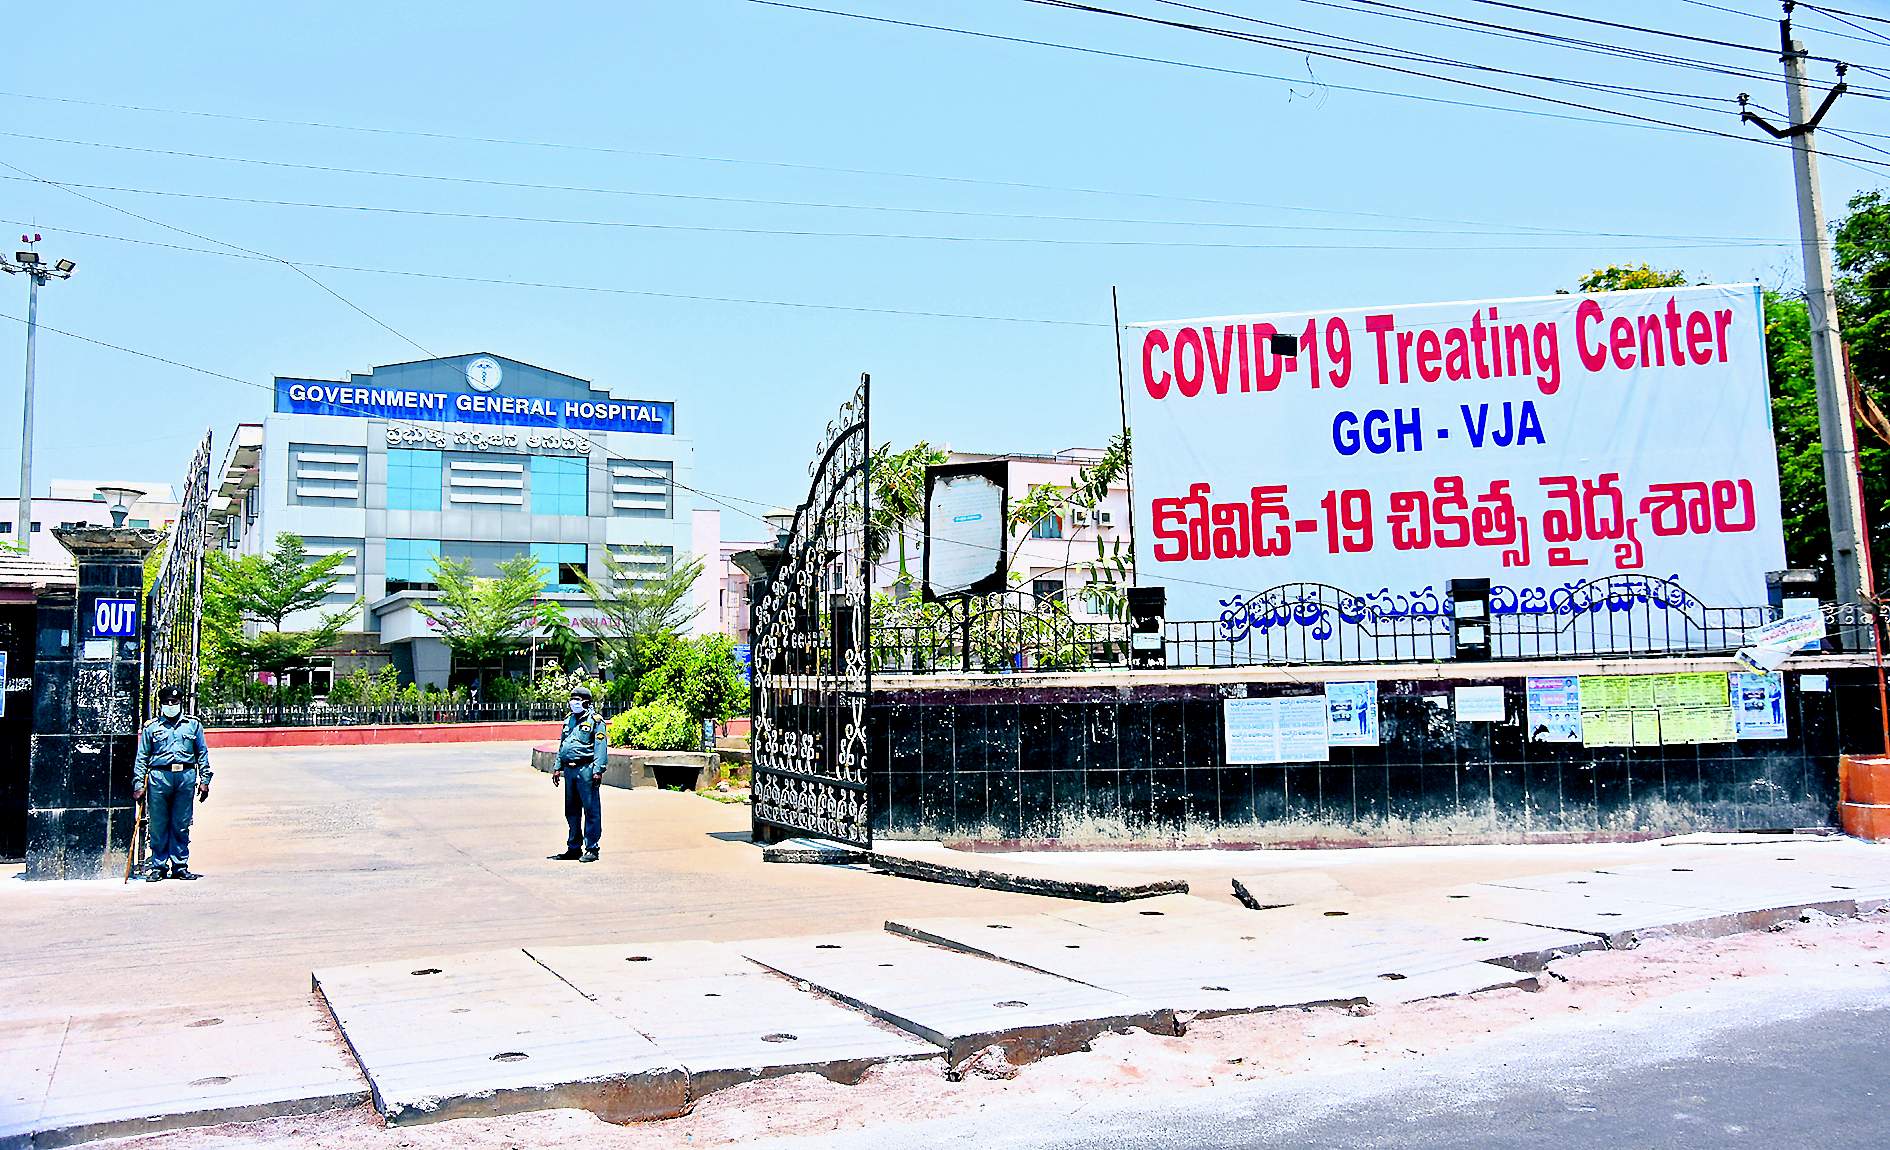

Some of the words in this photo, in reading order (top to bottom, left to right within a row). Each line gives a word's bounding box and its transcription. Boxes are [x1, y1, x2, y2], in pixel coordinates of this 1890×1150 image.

[1142, 316, 1352, 400] COVID-19
[1365, 307, 1561, 395] Treating
[1575, 296, 1733, 373] Center
[288, 384, 448, 410] GOVERNMENT
[456, 394, 557, 416] GENERAL
[565, 401, 663, 422] HOSPITAL
[385, 426, 447, 448] ప్రభుత్వ
[1332, 407, 1423, 456] GGH
[1459, 400, 1546, 448] VJA
[1151, 482, 1374, 563] కోవిడ్-19
[1386, 475, 1531, 568] చికిత్స
[96, 602, 136, 633] OUT
